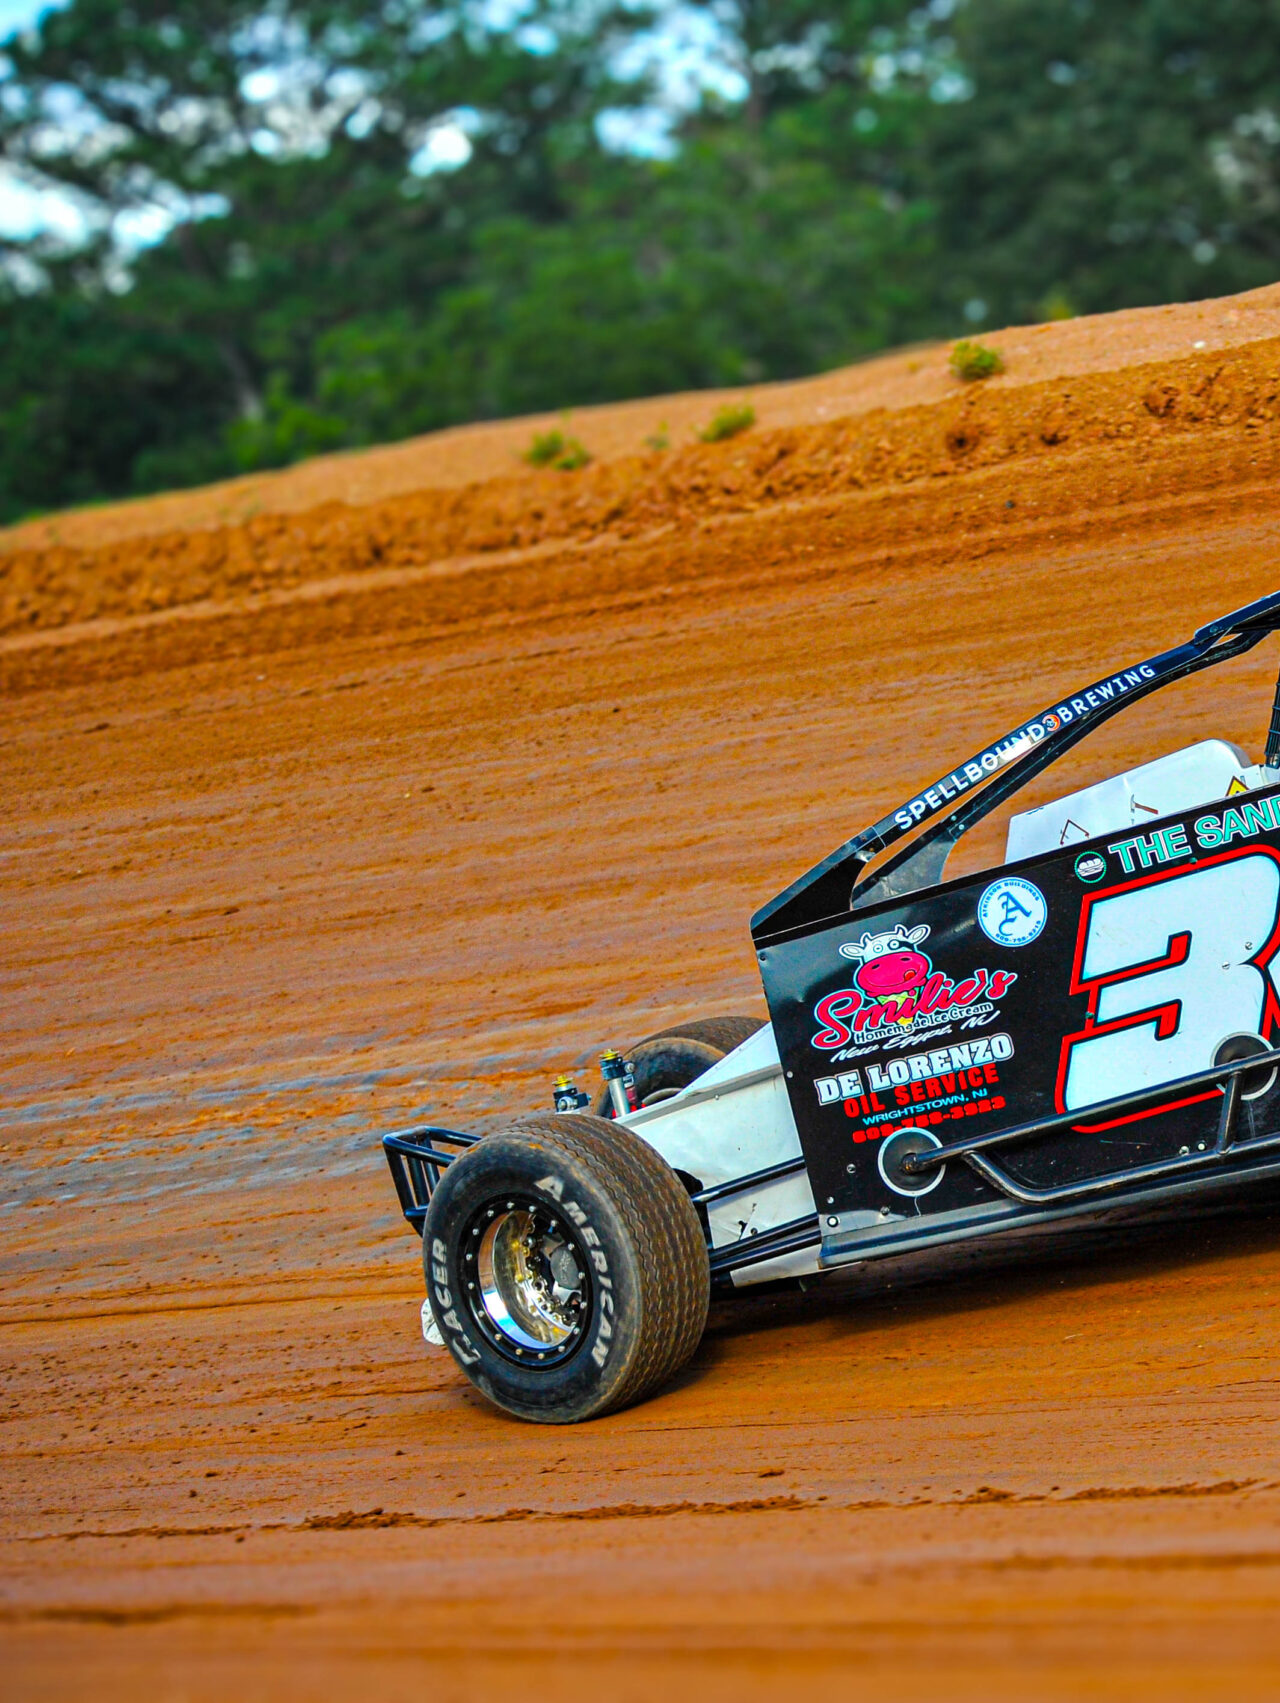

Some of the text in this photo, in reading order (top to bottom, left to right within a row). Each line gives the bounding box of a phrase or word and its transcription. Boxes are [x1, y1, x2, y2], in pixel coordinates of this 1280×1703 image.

[1057, 663, 1156, 723] BREWING
[1107, 824, 1192, 874] THE
[811, 967, 1018, 1050] Smilie's
[854, 1002, 994, 1044] Homemade Ice Cream
[830, 1044, 880, 1063] New
[960, 1010, 1001, 1030] NJ
[813, 1032, 1015, 1106] DE LORENZO
[843, 1062, 1000, 1118] OIL SERVICE
[972, 1088, 988, 1098] NJ
